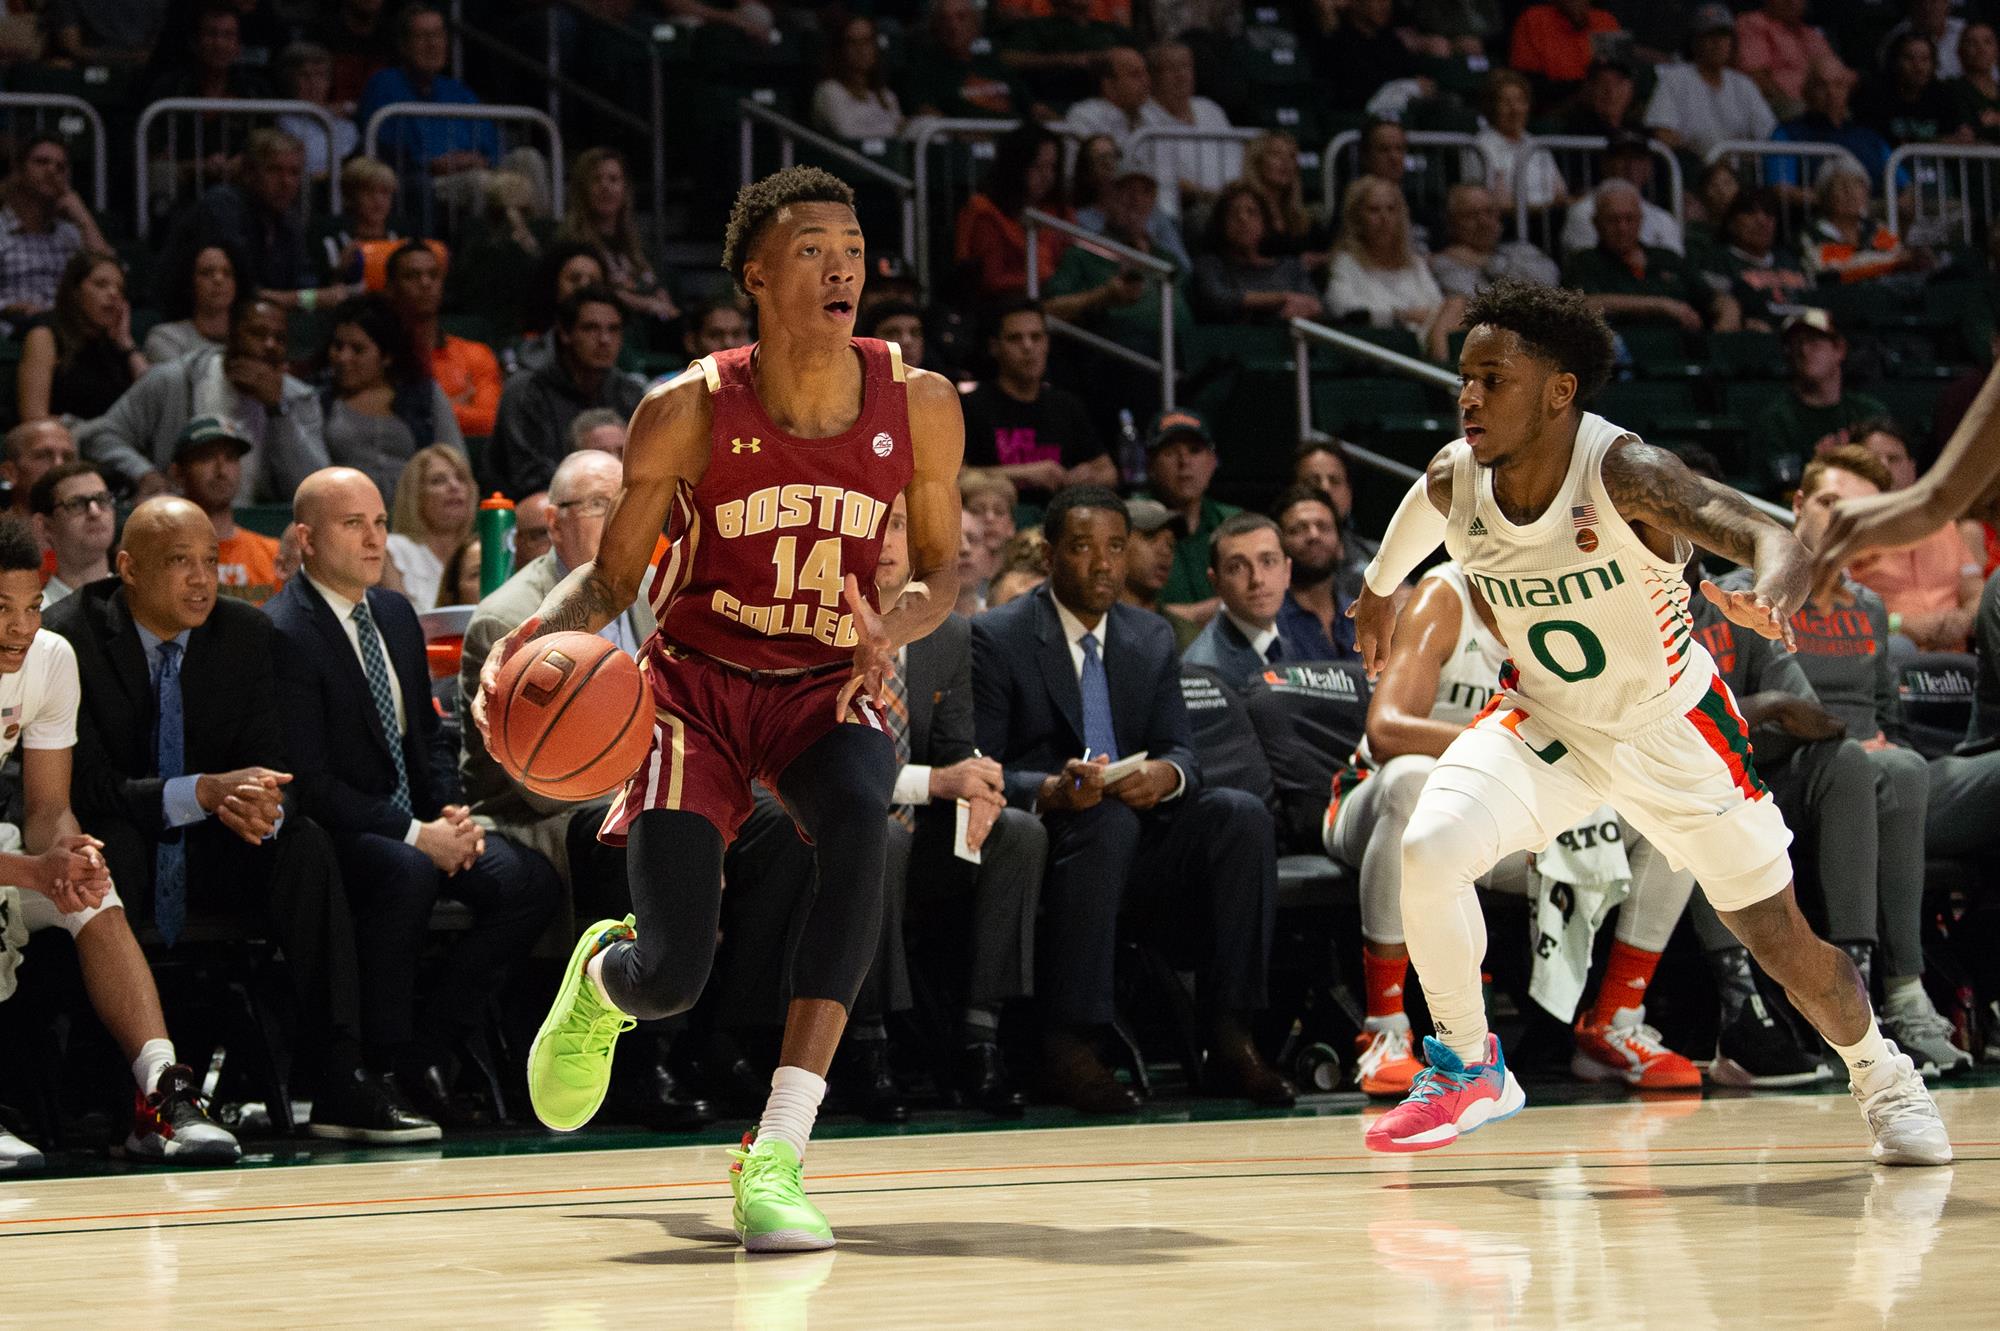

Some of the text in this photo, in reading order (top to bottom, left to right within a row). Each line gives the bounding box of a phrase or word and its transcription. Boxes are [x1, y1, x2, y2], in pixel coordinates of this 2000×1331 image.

[1467, 528, 1488, 536] adidas
[772, 536, 845, 607] 14
[711, 589, 859, 648] COLLEG
[1527, 619, 1607, 683] 0
